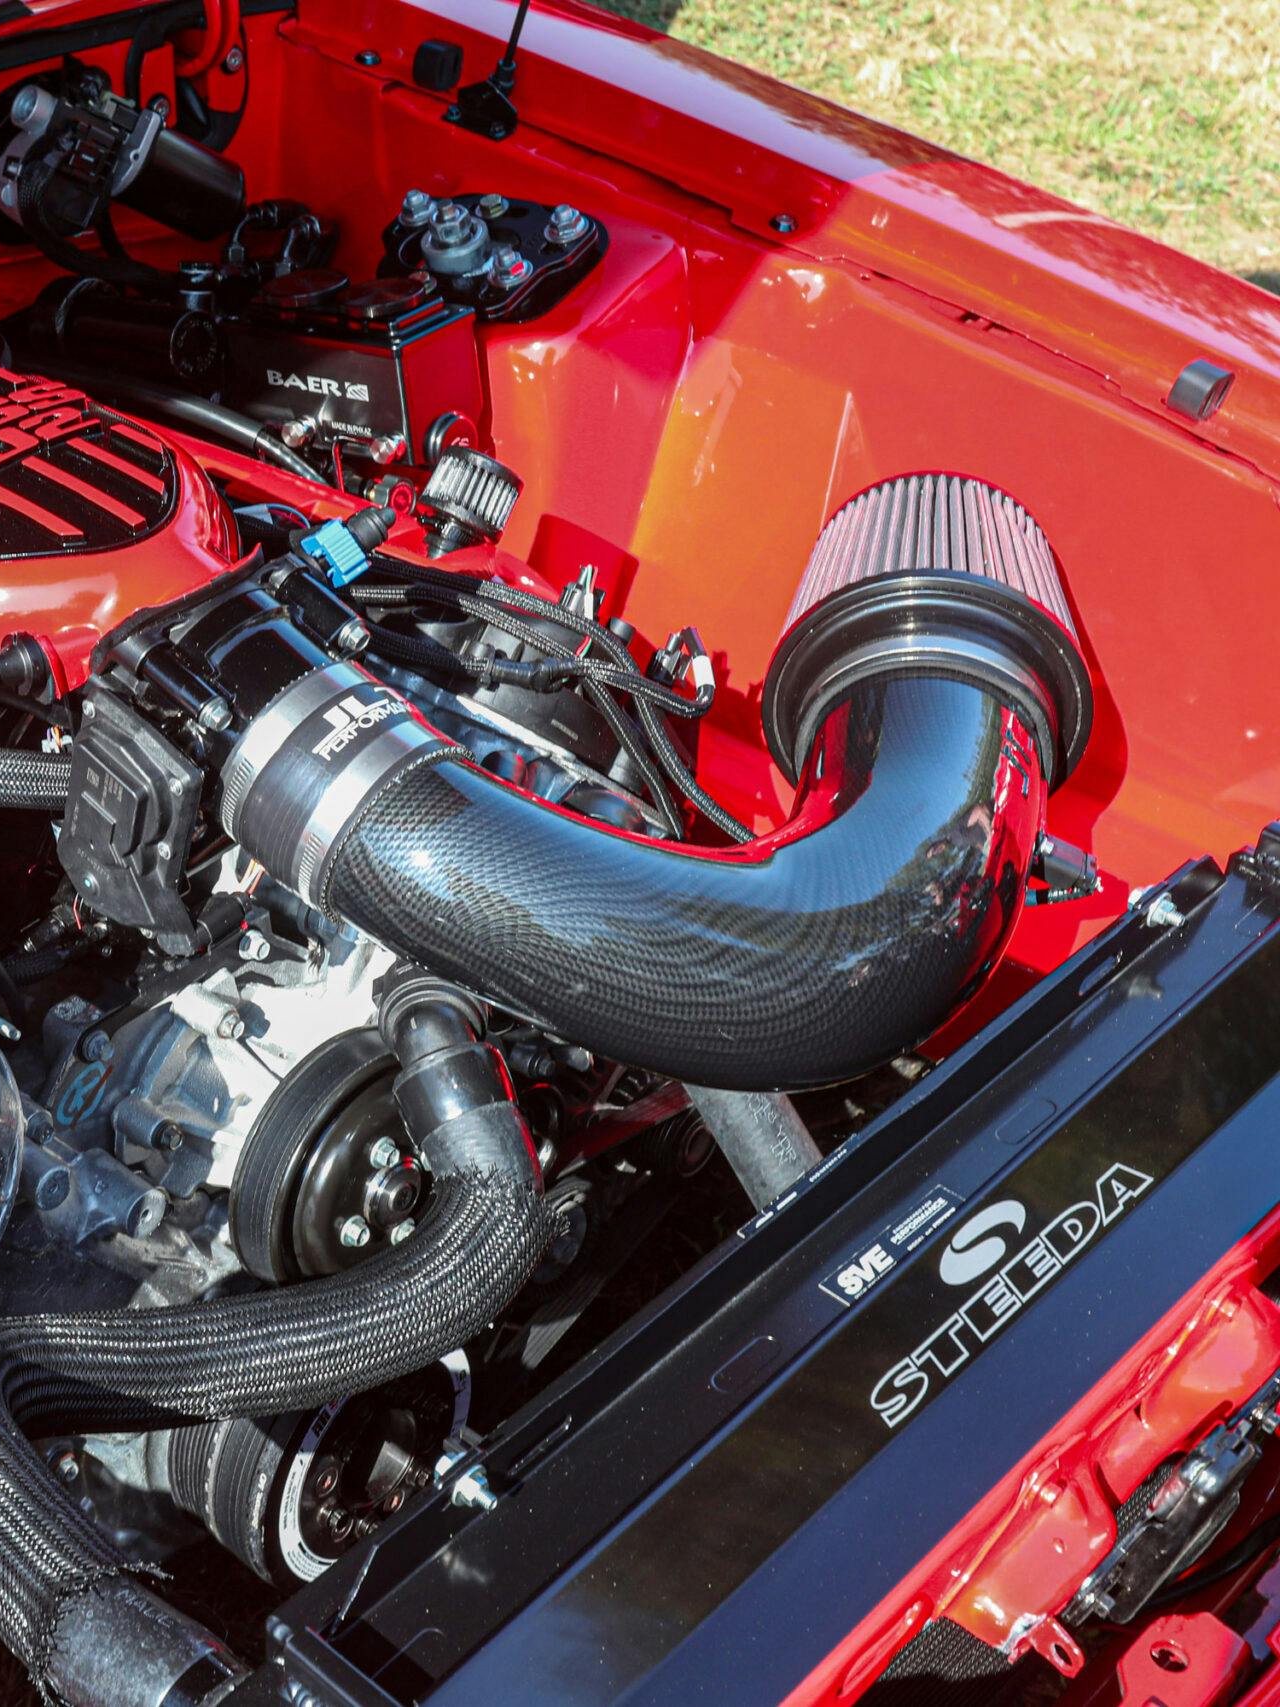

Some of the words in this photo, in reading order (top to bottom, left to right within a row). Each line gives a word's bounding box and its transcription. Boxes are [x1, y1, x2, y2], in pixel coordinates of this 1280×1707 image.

[266, 369, 342, 397] BAER
[890, 1197, 948, 1244] PERFORMANCE
[836, 1243, 895, 1296] SVE
[870, 1162, 1155, 1429] STEEDA
